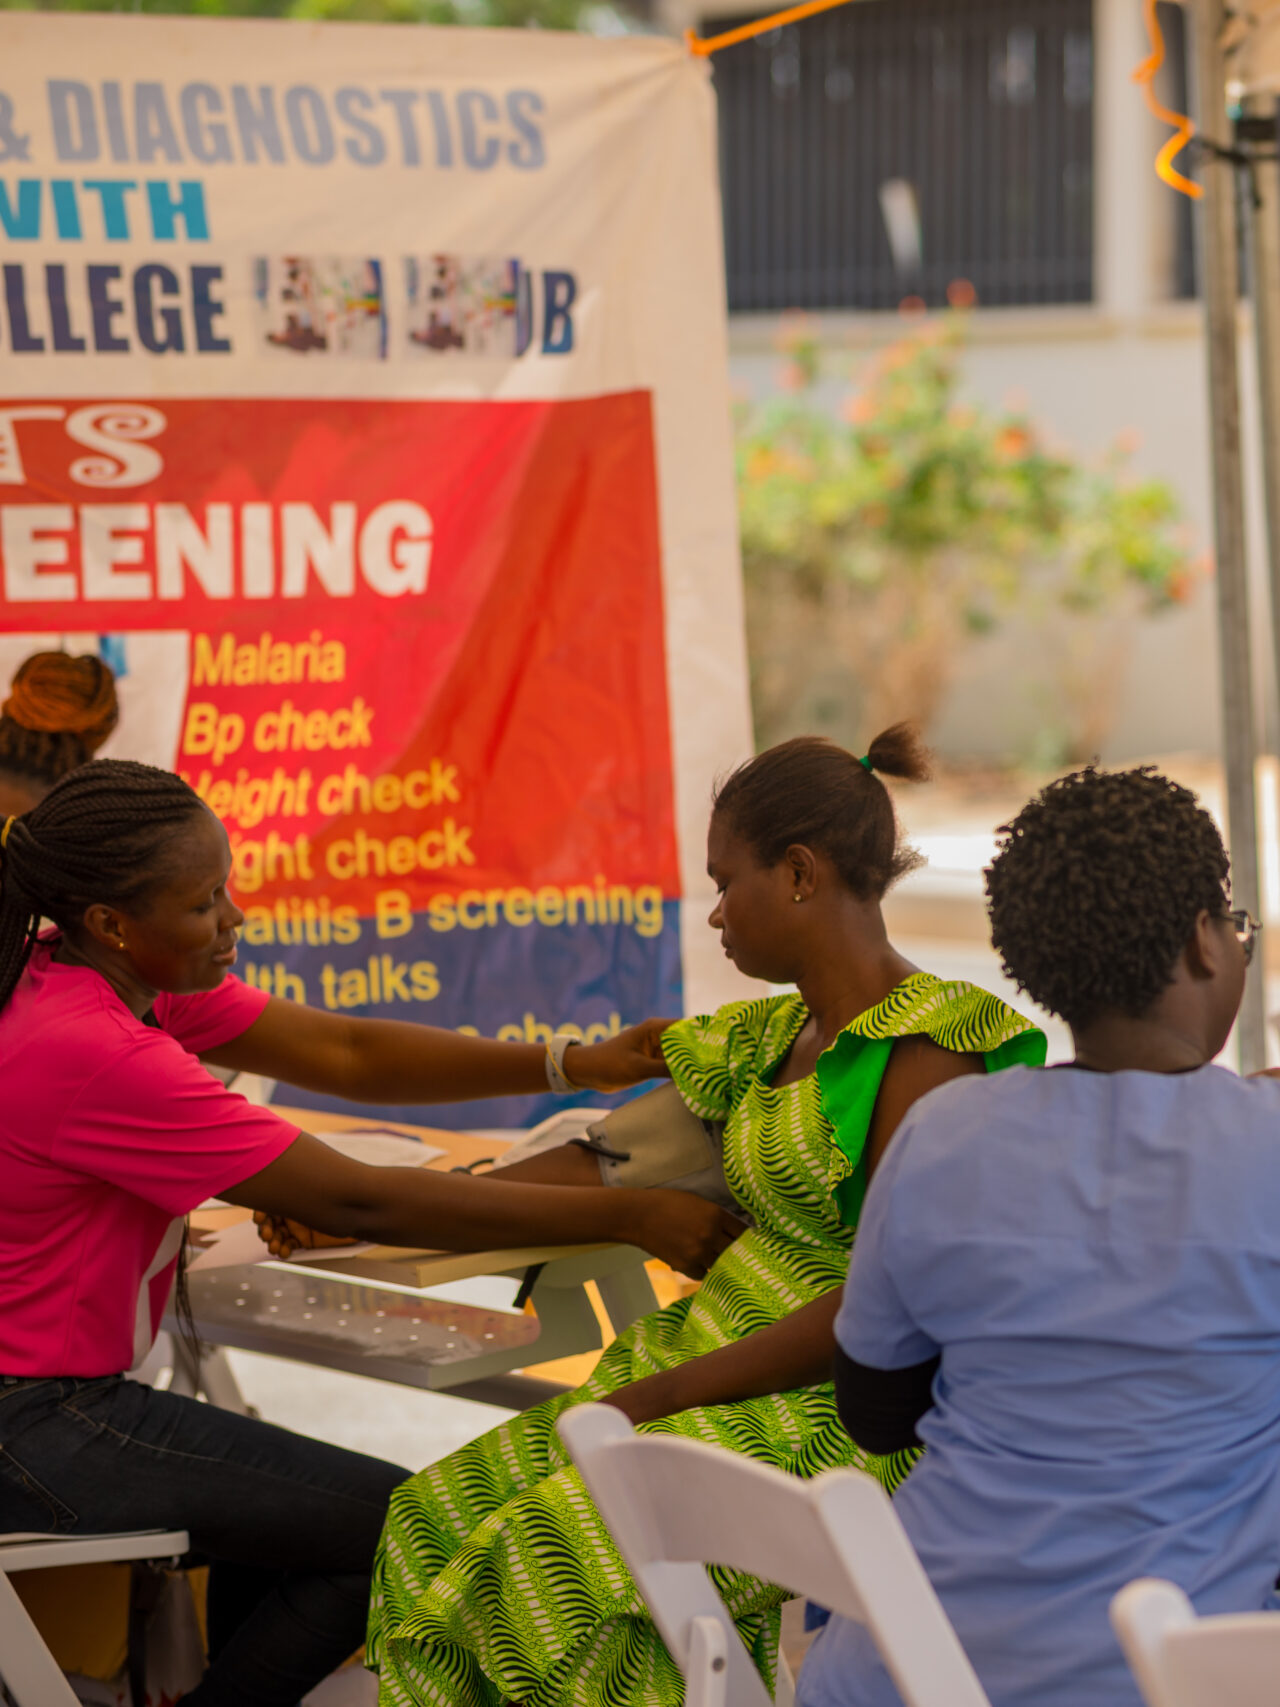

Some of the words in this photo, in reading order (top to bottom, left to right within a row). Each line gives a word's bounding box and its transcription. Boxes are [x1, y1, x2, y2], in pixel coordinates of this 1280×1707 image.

[46, 78, 547, 172] DIAGNOSTICS
[2, 262, 232, 356] LLEGE
[1, 502, 434, 602] EENING
[193, 632, 346, 688] Malaria
[182, 703, 245, 767] Bp
[254, 699, 373, 753] check
[317, 760, 460, 816] check
[326, 820, 475, 879] check
[237, 894, 362, 946] atitis
[375, 888, 414, 939] B
[428, 877, 664, 938] screening
[320, 953, 441, 1010] talks
